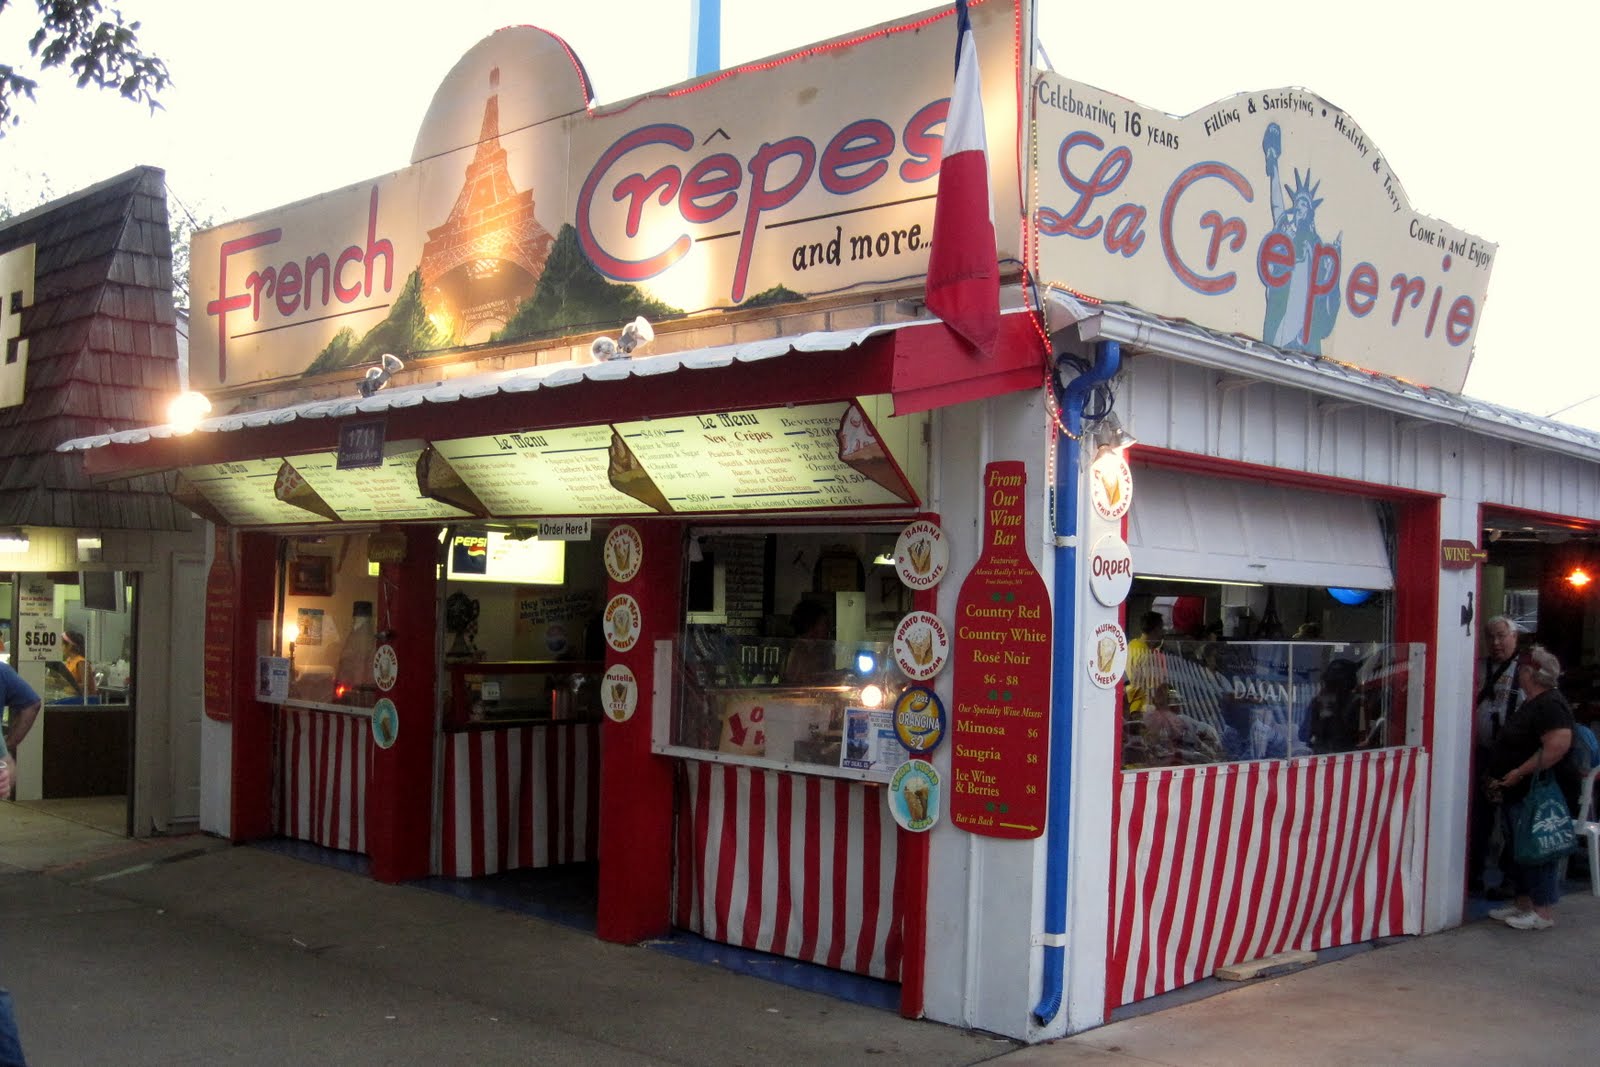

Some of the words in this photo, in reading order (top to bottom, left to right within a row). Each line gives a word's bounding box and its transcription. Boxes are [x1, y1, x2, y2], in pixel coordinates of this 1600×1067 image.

[1247, 97, 1258, 114] &
[1123, 110, 1142, 137] 16
[1372, 157, 1381, 175] &
[1034, 130, 1147, 258] La
[1160, 160, 1475, 347] Creperie
[792, 226, 841, 272] and
[207, 184, 394, 384] French
[696, 415, 718, 430] Le
[715, 411, 760, 428] Menu
[780, 417, 841, 428] Beverages
[704, 433, 726, 445] New
[733, 429, 774, 444] Crêpes
[806, 427, 837, 438] $2.00
[493, 436, 513, 450] Le
[510, 434, 549, 449] Menu
[988, 470, 1022, 487] From
[822, 484, 850, 494] Milk
[830, 496, 864, 505] Coffee
[992, 490, 1019, 507] Our
[1096, 500, 1111, 517] WHIP
[1111, 493, 1129, 517] CREAM
[990, 509, 1022, 526] Wine
[544, 523, 563, 536] Order
[565, 521, 583, 535] Here
[904, 524, 941, 541] BANANA
[454, 536, 487, 547] PEPSI
[609, 528, 642, 556] STRAWBERRY
[992, 529, 1017, 546] Bar
[1443, 546, 1471, 563] WINE
[902, 564, 944, 585] CHOCOLATE
[1018, 568, 1035, 576] Wine
[1092, 555, 1131, 581] ORDER
[605, 597, 627, 623] CHICKEN
[966, 603, 1015, 622] Country
[1018, 605, 1041, 619] Red
[25, 631, 56, 647] $5.00
[897, 614, 919, 641] POTATO
[920, 614, 946, 647] CHEDDAR
[959, 626, 1008, 645] Country
[1010, 628, 1047, 643] White
[1095, 623, 1125, 652] MUSHROOM
[613, 635, 635, 648] CHEESE
[1003, 650, 1031, 665] Noir
[899, 658, 916, 677] SOUR
[920, 656, 943, 677] CREAM
[606, 674, 634, 682] nutella
[983, 673, 997, 685] $6
[1005, 674, 1019, 686] $8
[1094, 672, 1117, 685] CHEESE
[1233, 680, 1297, 703] DASANI
[958, 703, 972, 713] Our
[972, 704, 1003, 719] Specialty
[1003, 705, 1021, 717] Wine
[898, 711, 941, 731] ORANGINA
[956, 719, 1006, 736] Mimosa
[1027, 728, 1039, 739] $6
[910, 735, 924, 751] $2
[955, 743, 1001, 763] Sangria
[1026, 753, 1038, 764] $8
[955, 768, 970, 781] Ice
[970, 769, 997, 784] Wine
[955, 781, 965, 793] &
[967, 781, 1000, 797] Berries
[1025, 784, 1037, 795] $8
[955, 813, 968, 823] Bar
[969, 814, 977, 824] in
[977, 815, 994, 826] Back
